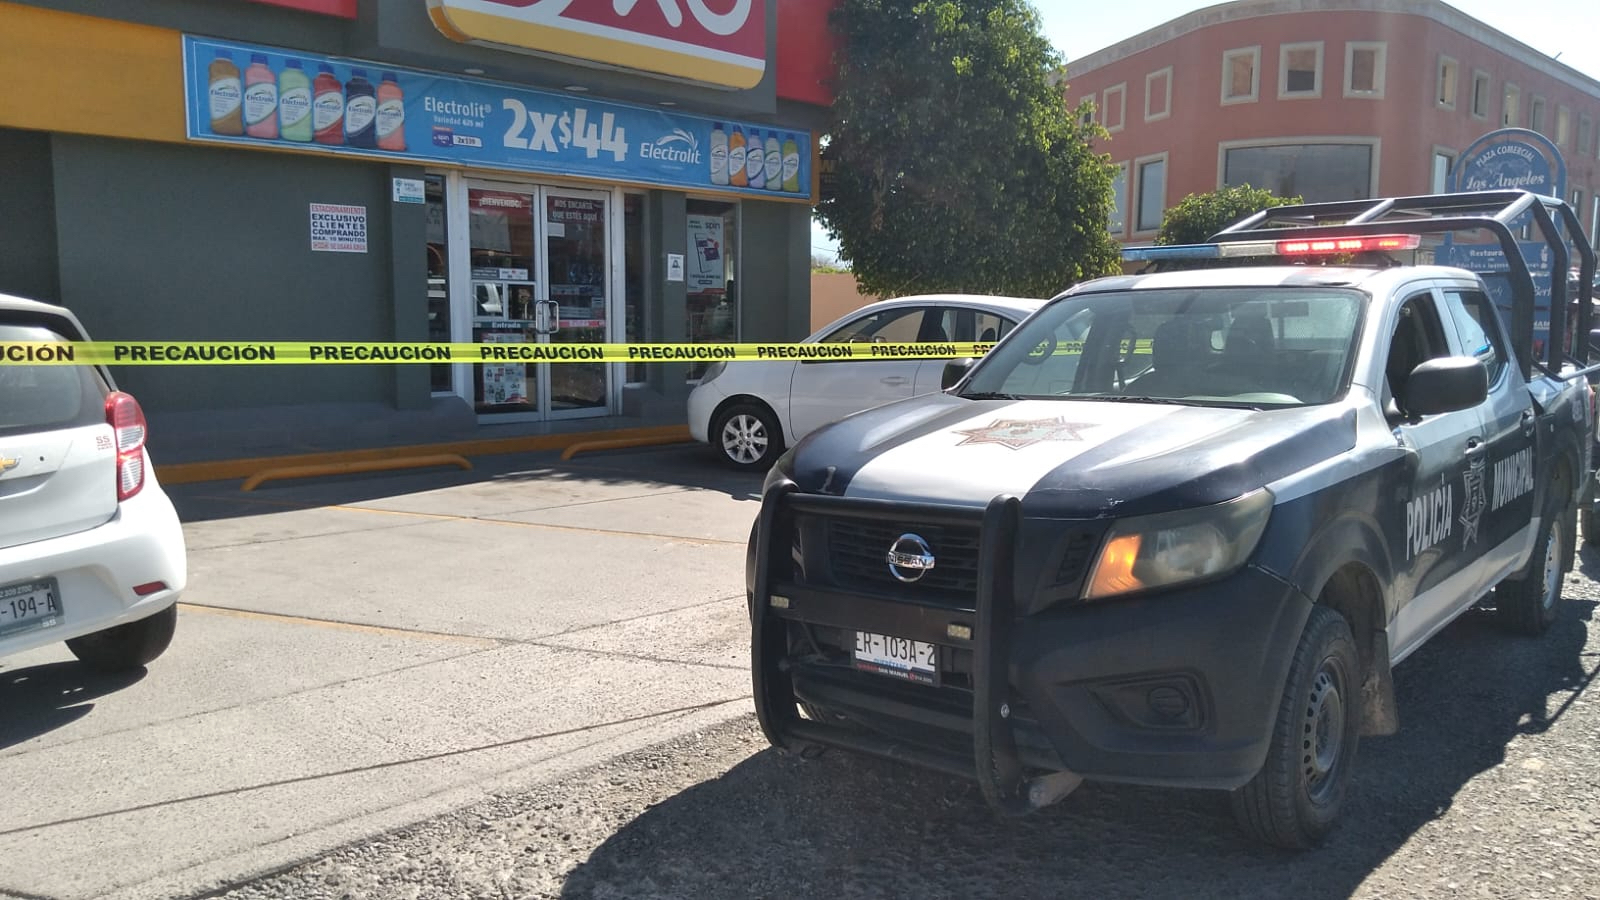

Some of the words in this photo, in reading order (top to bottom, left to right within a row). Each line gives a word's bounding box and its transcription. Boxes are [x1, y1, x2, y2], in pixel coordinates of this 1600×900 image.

[640, 140, 701, 165] Electrolit
[1476, 149, 1497, 168] PLAZA
[1496, 145, 1536, 163] COMERCIAL
[1489, 170, 1545, 190] Angeles
[311, 213, 365, 223] EXCLUSIVO
[312, 221, 366, 230] CLIENTES
[312, 229, 366, 237] COMPRANDO
[1470, 249, 1505, 257] Restaura
[114, 343, 276, 361] PRECAUCIÓN
[309, 345, 452, 361] PRECAUCIÓN
[480, 346, 604, 360] PRECAUCIÓN
[628, 346, 736, 360] PRECAUCIÓN
[757, 345, 852, 358] PRECAUCIÓN
[870, 343, 957, 357] PRECAUCIÓN
[1406, 472, 1452, 561] POLICÍA
[1492, 446, 1534, 512] MUNICIPAL
[888, 553, 928, 567] NISSAN
